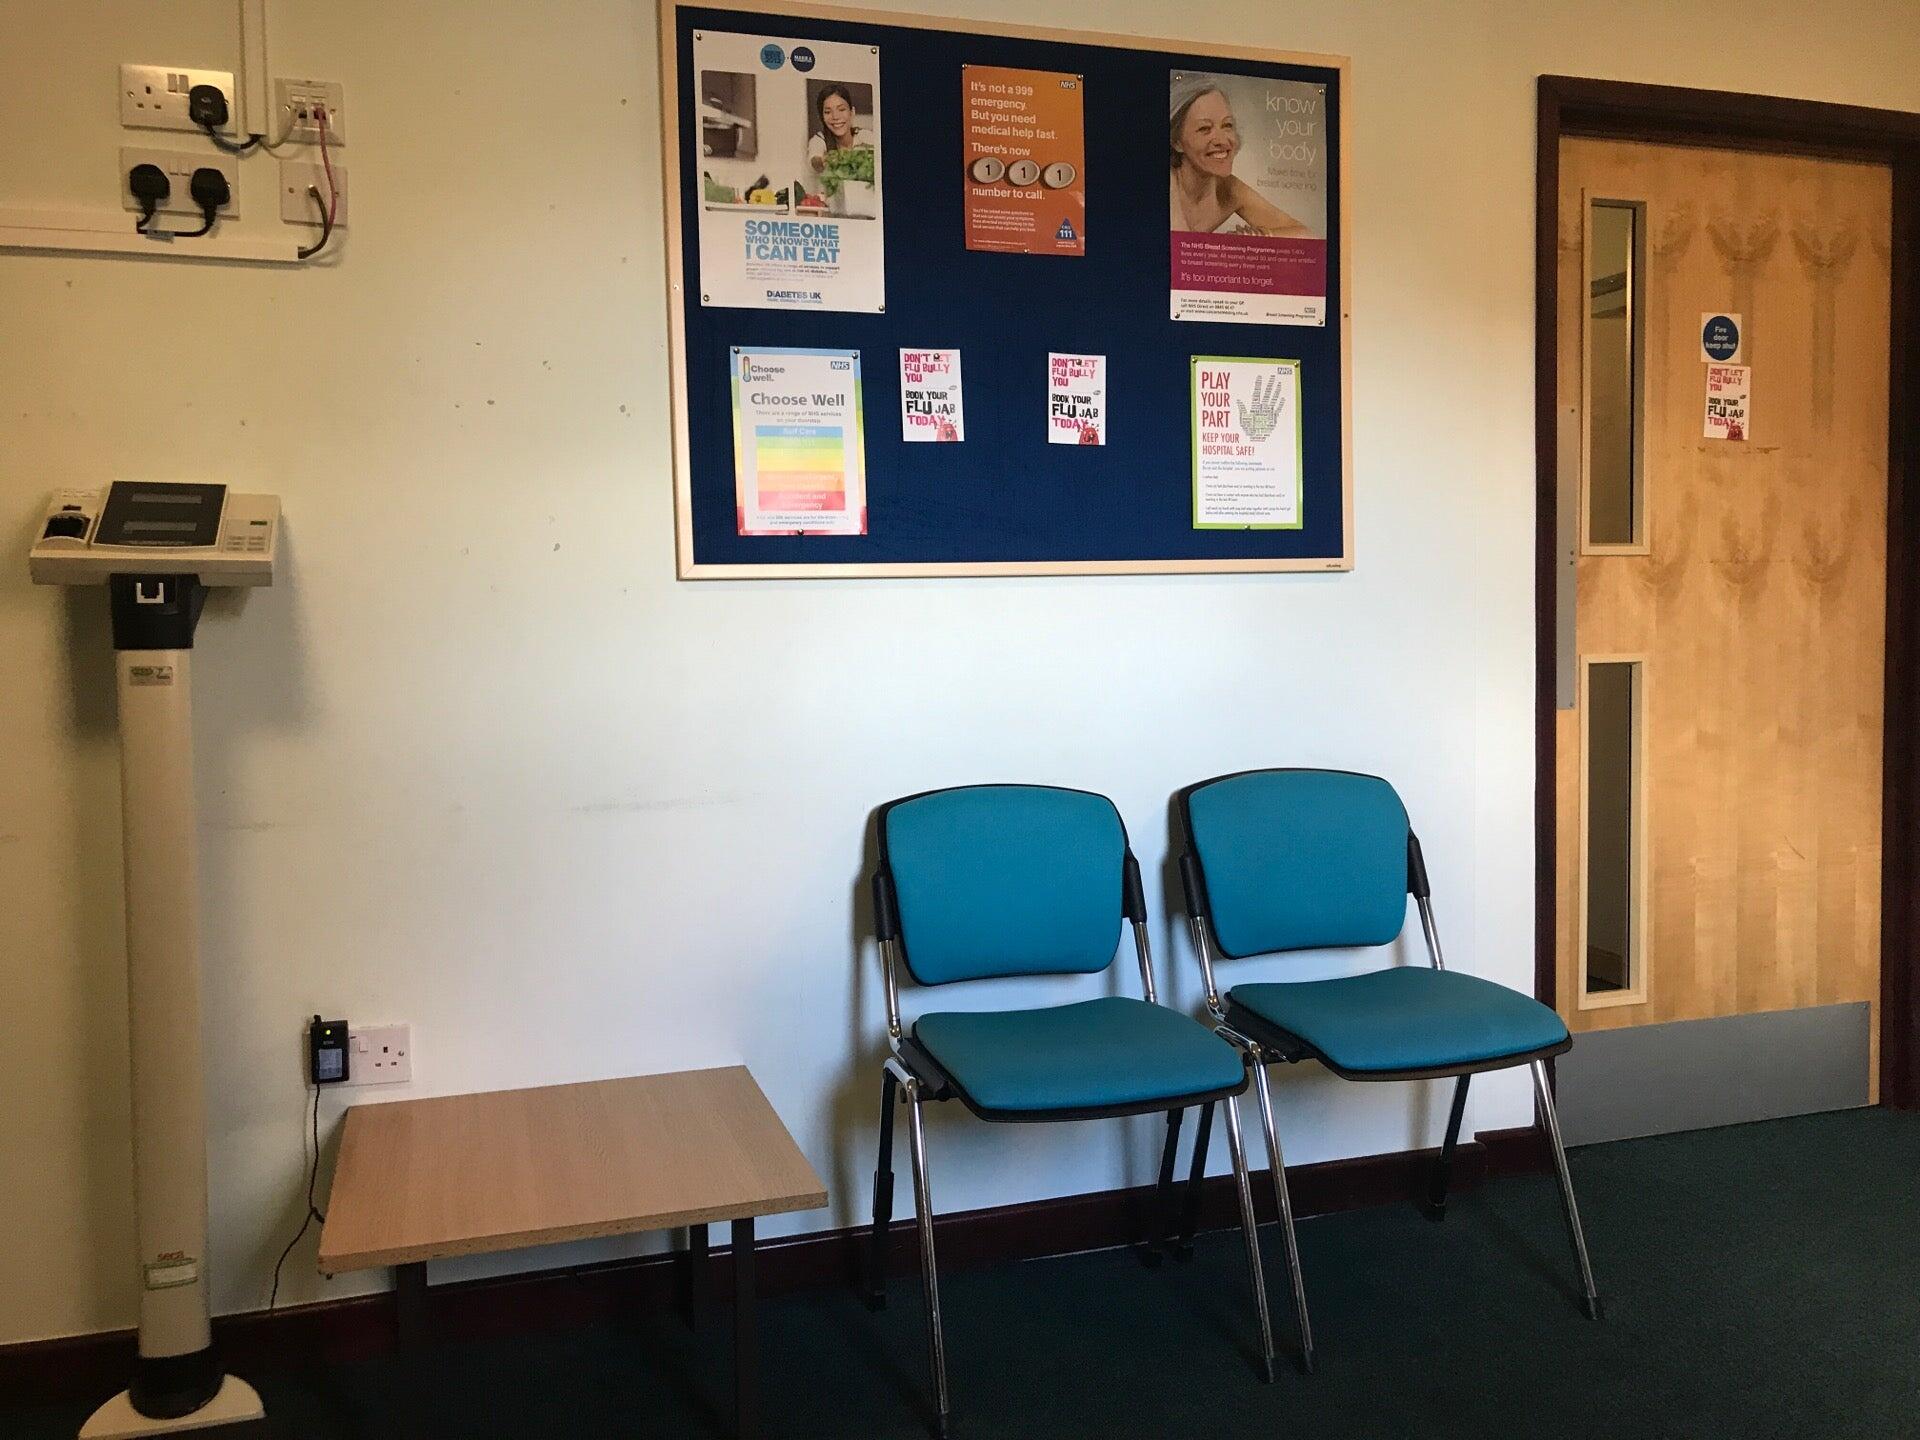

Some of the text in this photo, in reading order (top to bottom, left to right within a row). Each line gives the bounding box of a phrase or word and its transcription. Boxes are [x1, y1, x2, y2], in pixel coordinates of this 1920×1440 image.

[971, 81, 985, 91] It's
[989, 84, 1006, 93] not
[1016, 86, 1033, 96] 999
[1060, 81, 1076, 89] NHS
[1266, 91, 1316, 114] know
[971, 110, 1036, 124] But you need
[971, 125, 1057, 139] medical help fast.
[1276, 120, 1319, 138] your
[971, 142, 1030, 156] There's now
[1270, 140, 1316, 167] body
[972, 187, 1045, 200] number to call.
[745, 220, 839, 239] SOMEONE
[1060, 230, 1072, 238] 111
[745, 235, 839, 248] WHO KNOWS WHAT
[746, 244, 840, 263] I CAN EAT
[1181, 272, 1274, 288] It's too important to forget.
[810, 292, 821, 300] UK
[1706, 342, 1736, 350] keep shut
[904, 353, 930, 364] DON'T
[1052, 357, 1076, 368] DON'T
[751, 365, 785, 374] Choose
[831, 361, 849, 370] NHS
[904, 364, 950, 374] FLU BULLY
[905, 373, 922, 383] YOU
[1052, 367, 1095, 379] FLU BULLY
[1731, 369, 1744, 377] LET
[1052, 377, 1068, 386] YOU
[1202, 371, 1230, 389] PLAY
[1710, 383, 1721, 391] YOU
[751, 392, 845, 406] Choose Well
[906, 390, 947, 400] BOOK YOUR
[1052, 393, 1092, 404] BOOK YOUR
[1201, 391, 1230, 407] YOUR
[906, 400, 955, 415] FLU JAB
[1052, 403, 1098, 419] FLU JAB
[1708, 405, 1744, 418] FLU JAB
[907, 415, 945, 427] TODAY
[1052, 418, 1088, 429] TODAY
[1202, 410, 1230, 427] PART
[1202, 433, 1239, 443] KEEP YOUR
[1202, 445, 1254, 456] HOSPITAL SAFE!
